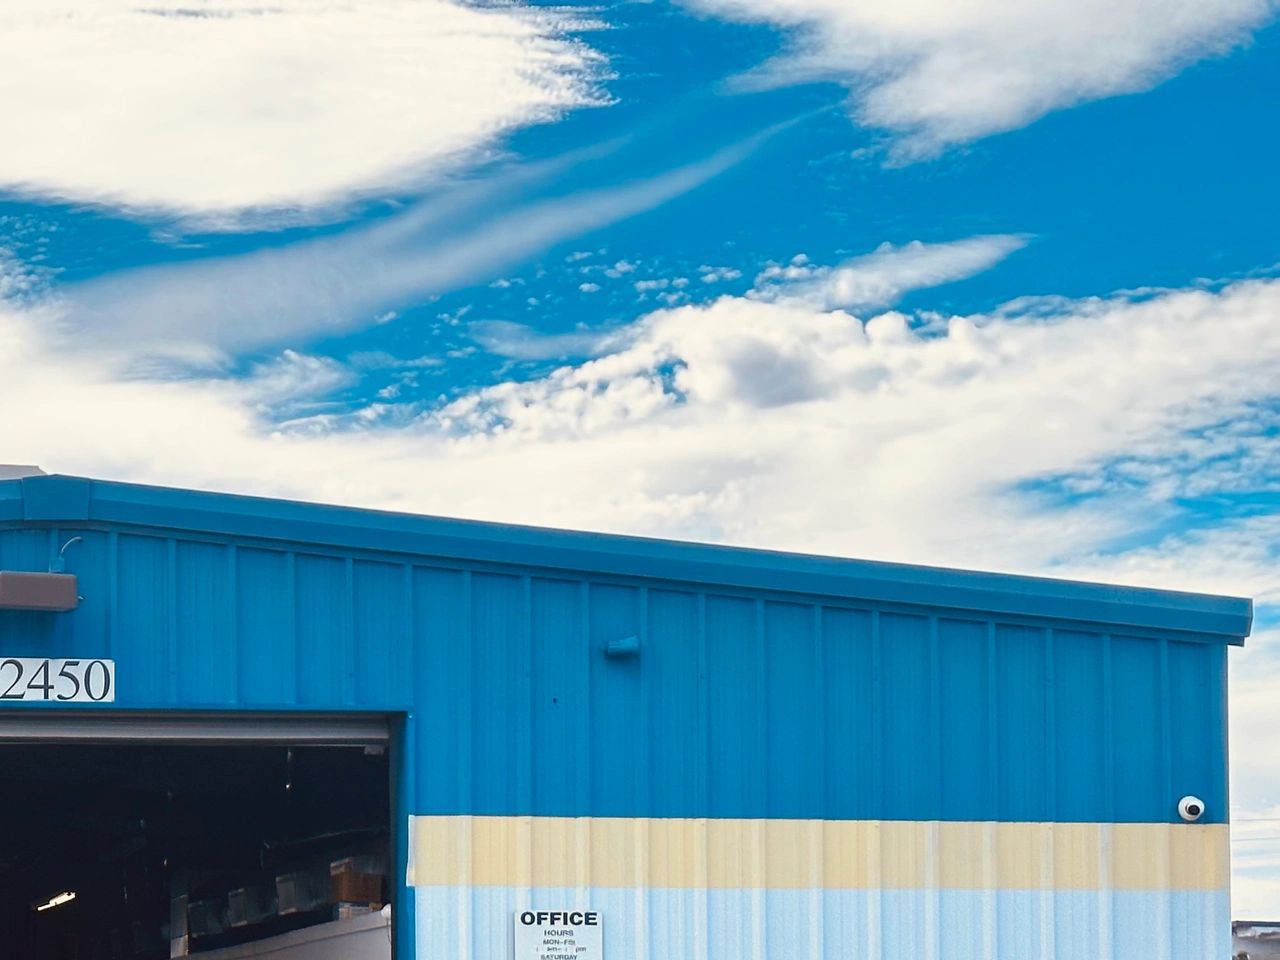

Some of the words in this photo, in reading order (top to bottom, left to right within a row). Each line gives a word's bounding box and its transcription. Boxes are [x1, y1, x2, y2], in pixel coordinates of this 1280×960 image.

[0, 659, 111, 700] 2450
[520, 911, 598, 926] OFFICE
[544, 929, 574, 937] HOURS
